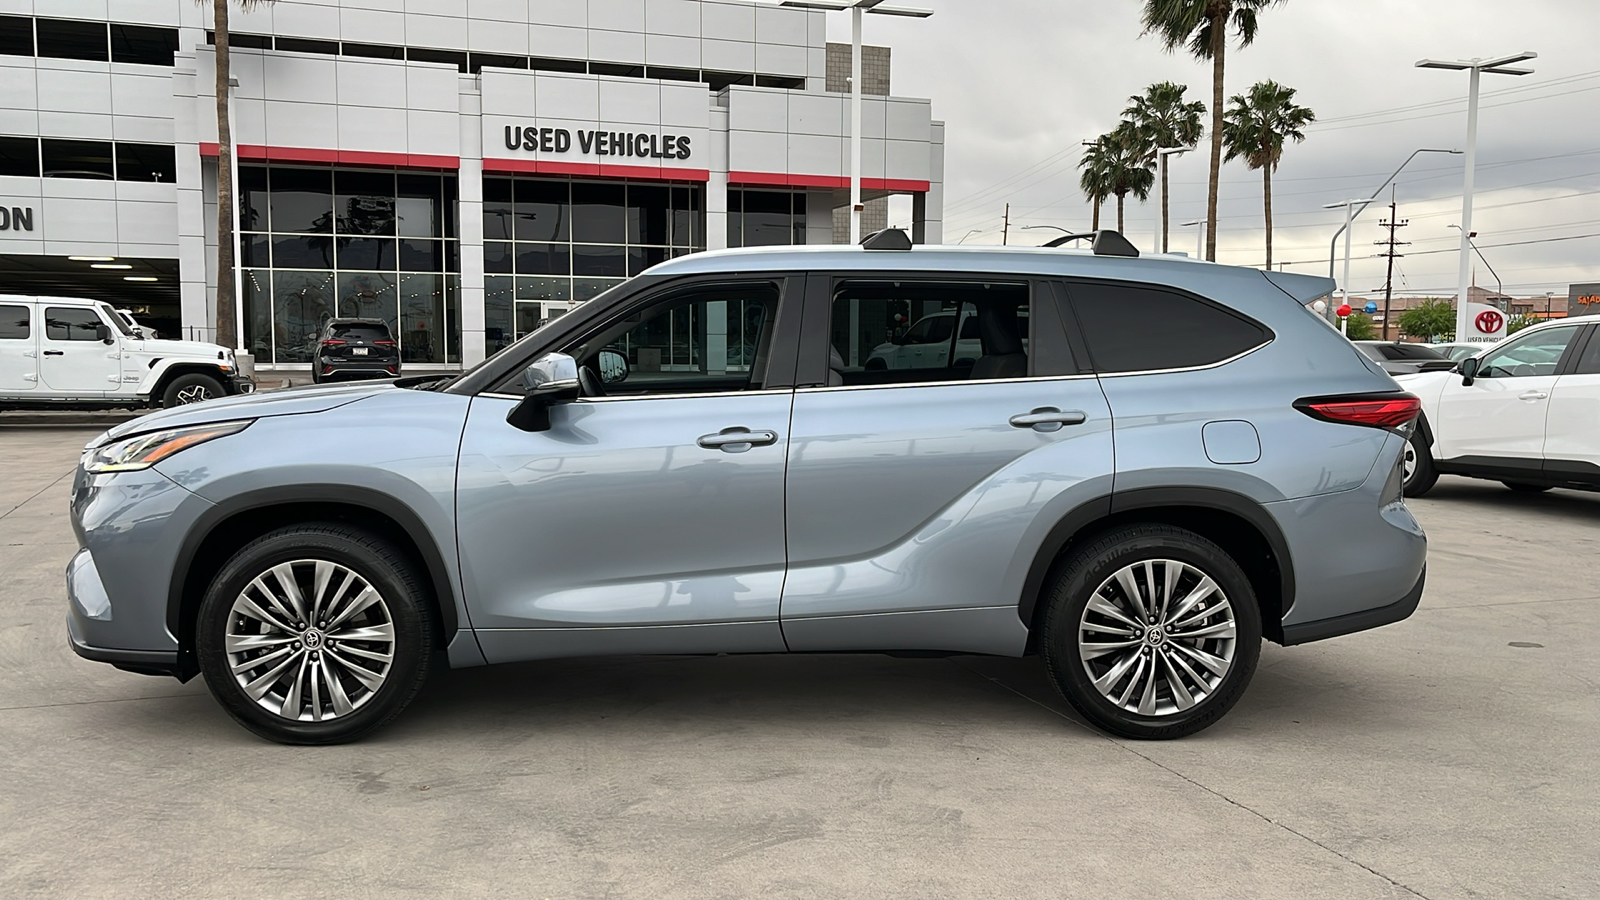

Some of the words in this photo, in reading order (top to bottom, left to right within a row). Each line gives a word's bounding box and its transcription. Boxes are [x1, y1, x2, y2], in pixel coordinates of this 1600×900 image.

[505, 126, 571, 153] USED
[578, 129, 691, 160] VEHICLES
[1084, 542, 1138, 582] Achilles
